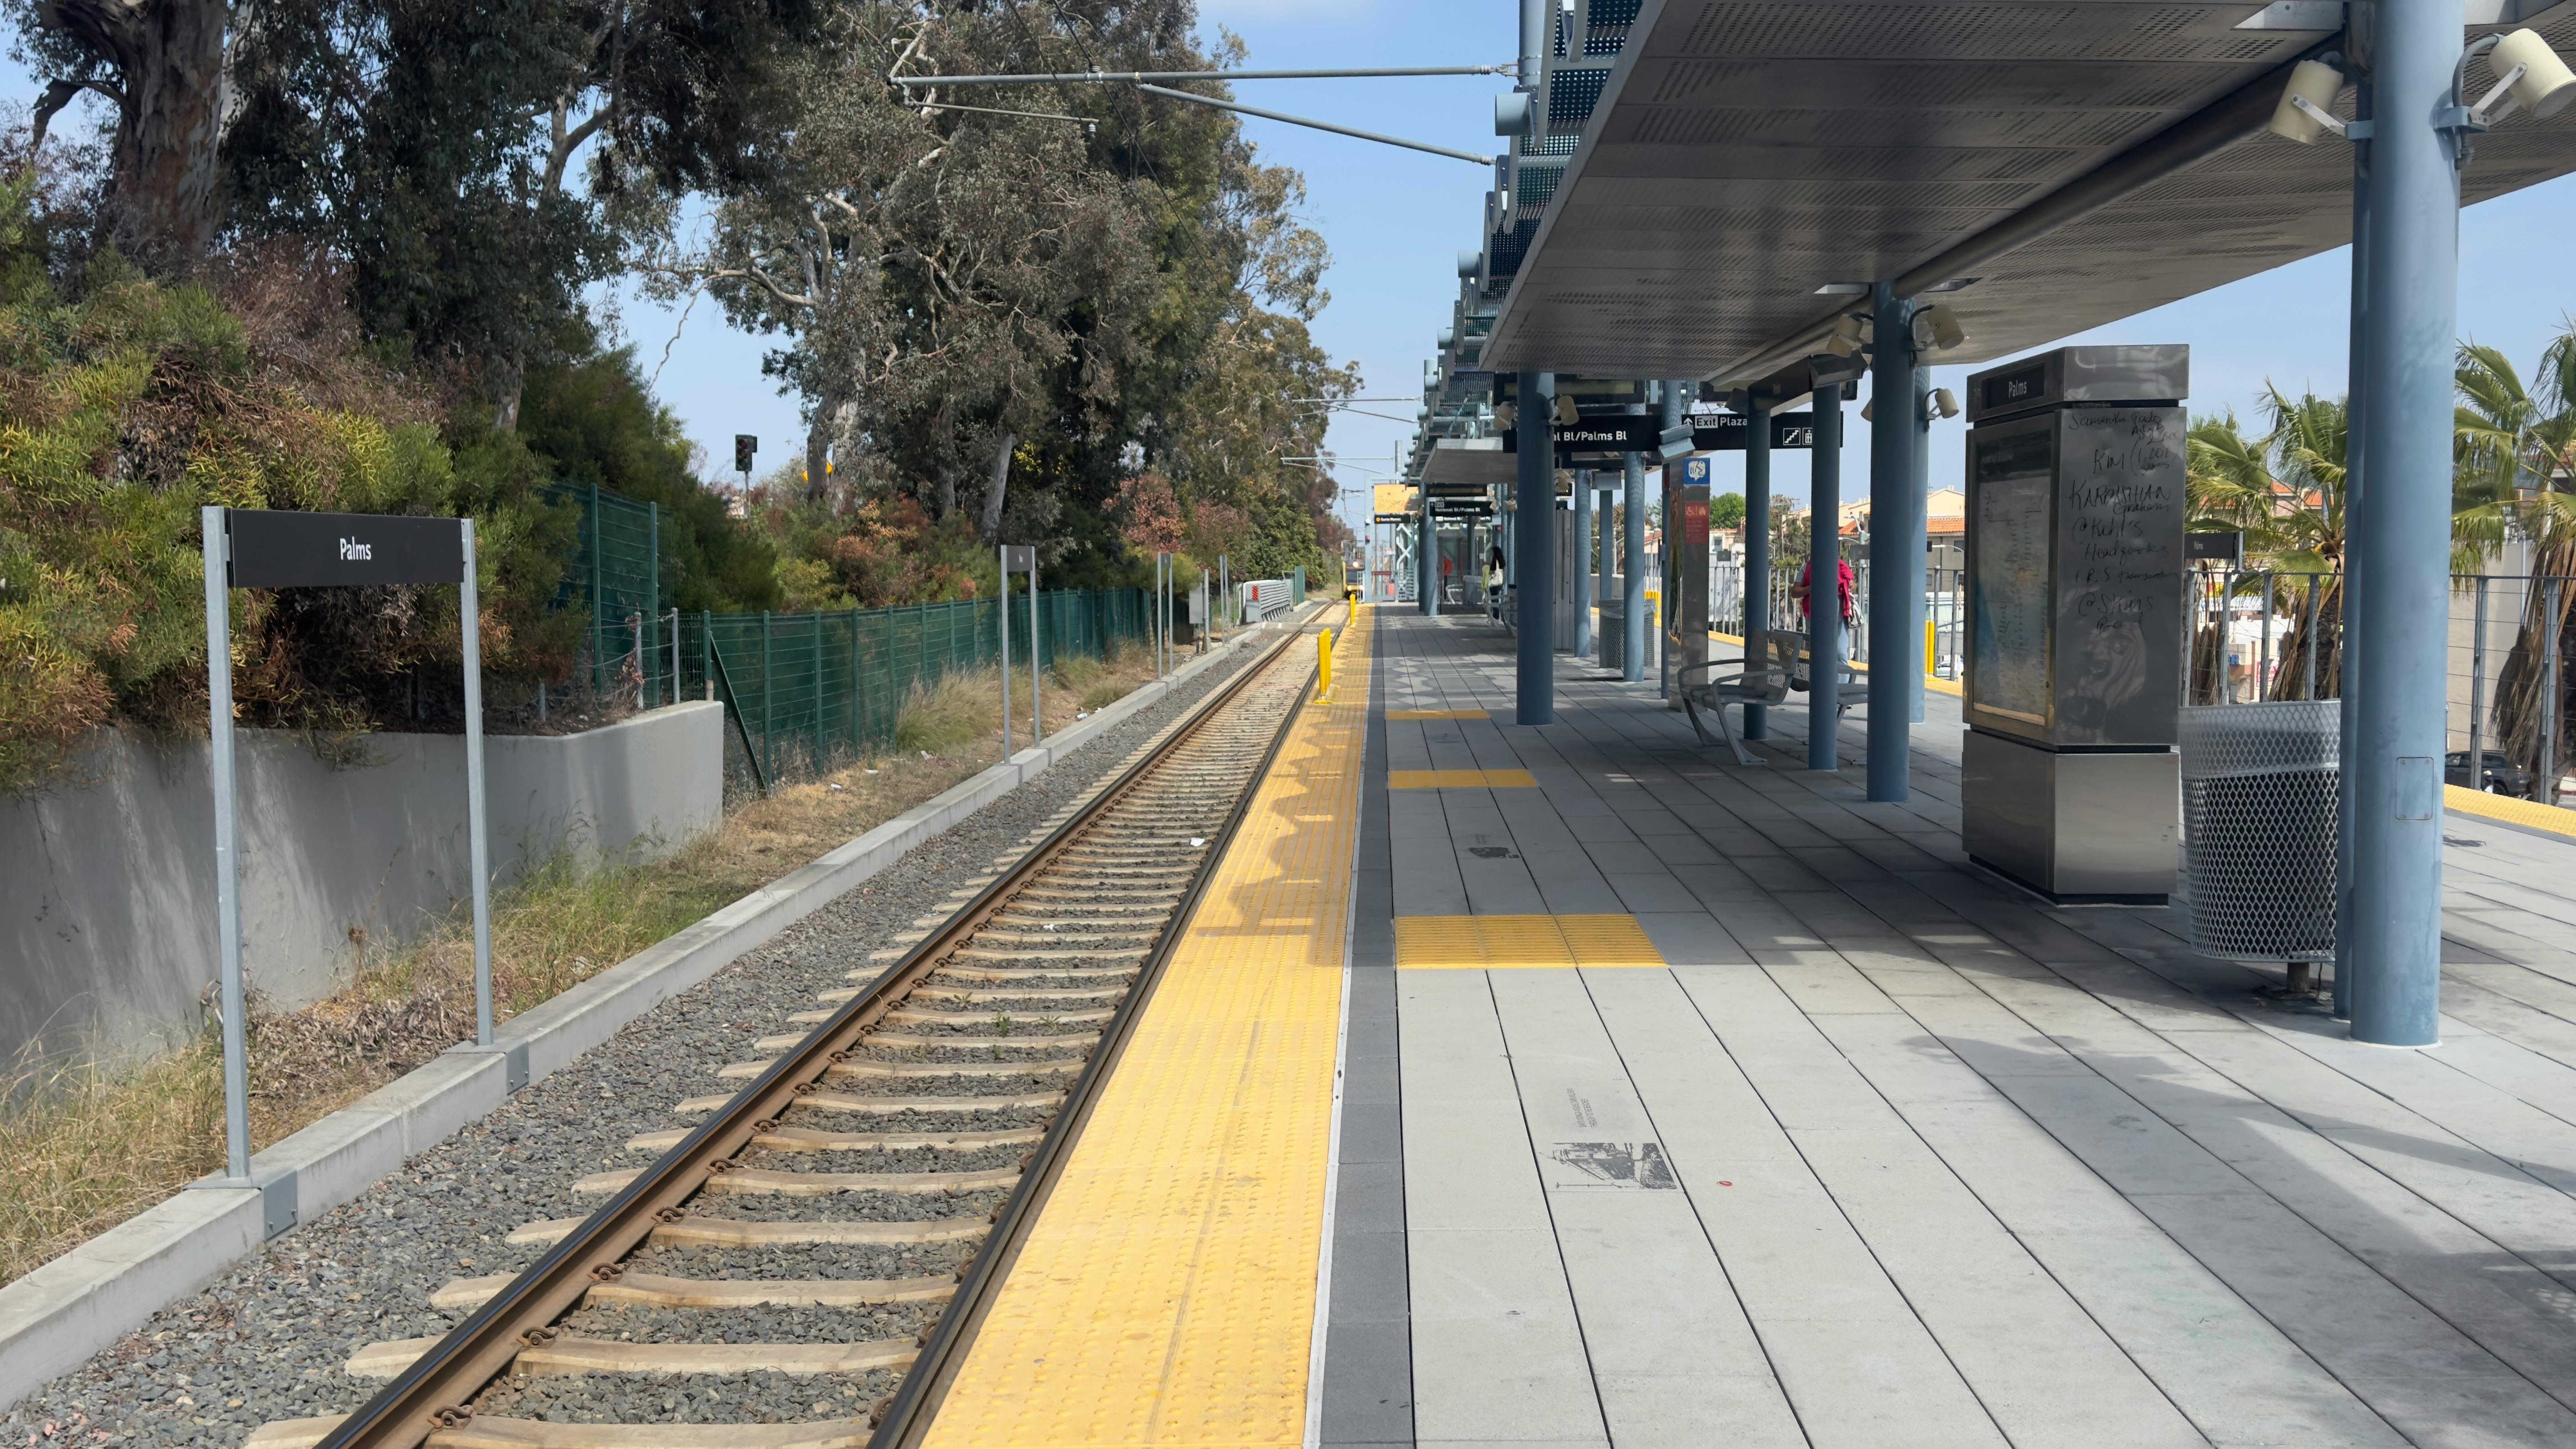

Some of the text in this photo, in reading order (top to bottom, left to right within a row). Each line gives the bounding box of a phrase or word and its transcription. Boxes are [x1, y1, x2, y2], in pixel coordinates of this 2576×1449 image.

[2009, 380, 2027, 398] Palms
[1697, 417, 1747, 426] Exit Plaza
[1616, 431, 1627, 441] Bl
[340, 536, 372, 560] Palms
